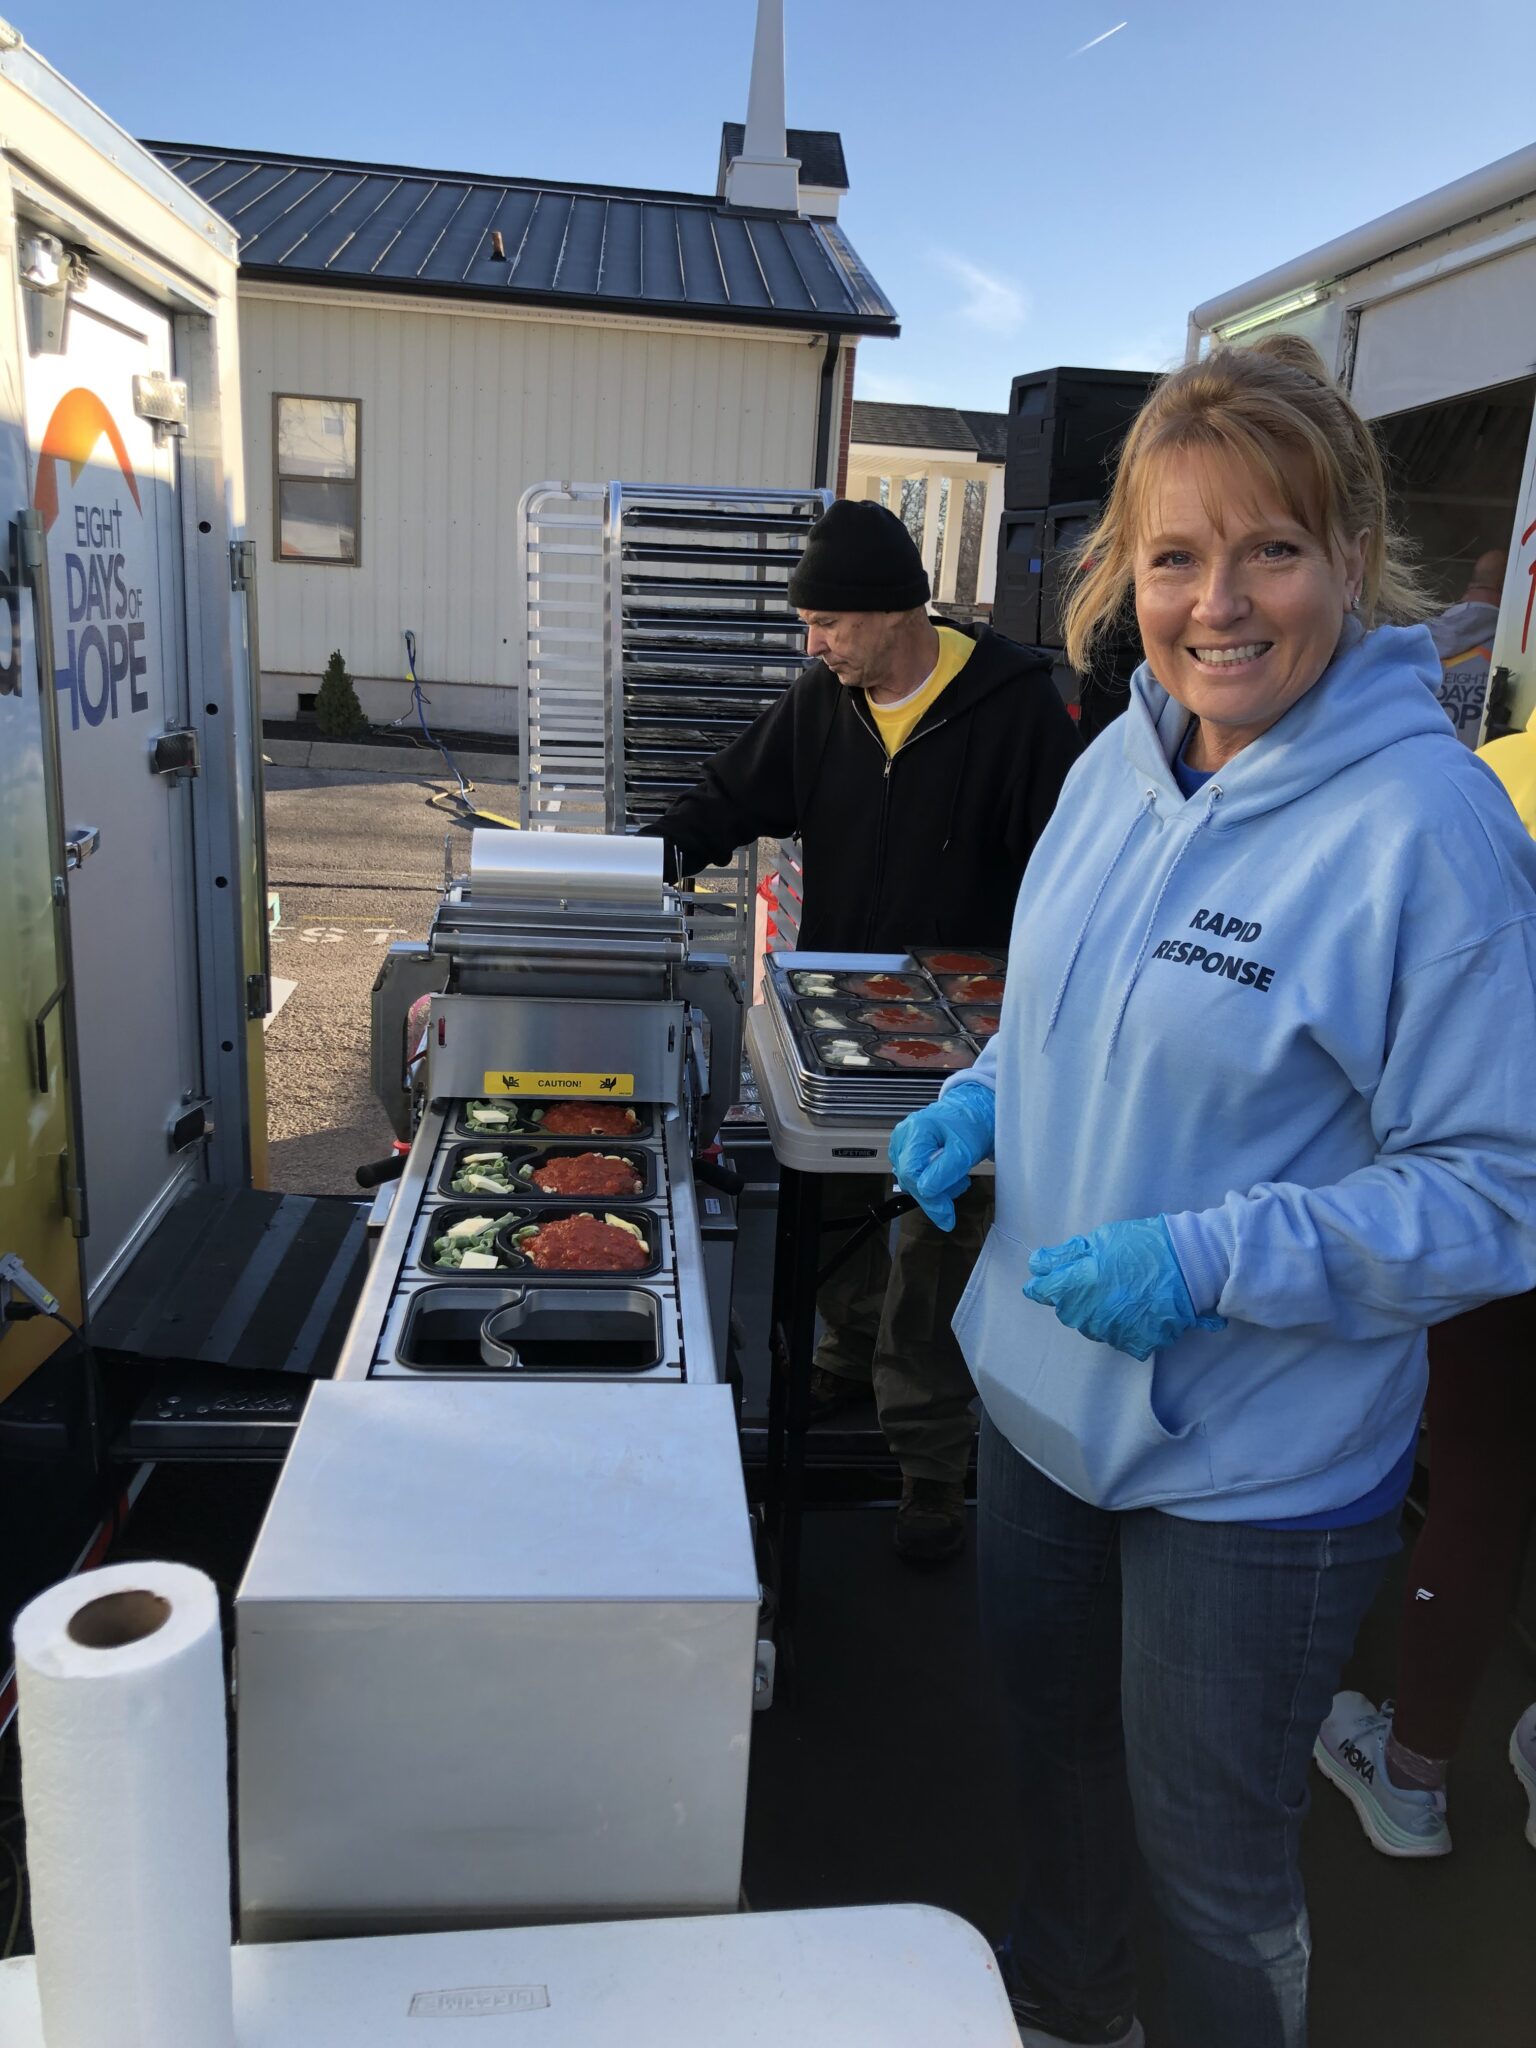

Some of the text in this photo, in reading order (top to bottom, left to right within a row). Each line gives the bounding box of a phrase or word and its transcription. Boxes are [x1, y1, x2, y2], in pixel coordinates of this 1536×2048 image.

[75, 498, 122, 549] EIGHT
[65, 552, 143, 623] DAYS OF
[55, 621, 149, 731] HOPE
[1444, 671, 1488, 684] EIGHT
[1189, 908, 1262, 943] RAPID
[1152, 940, 1276, 993] RESPONSE
[537, 1079, 582, 1088] CAUTION!
[1337, 1738, 1375, 1785] HOKA
